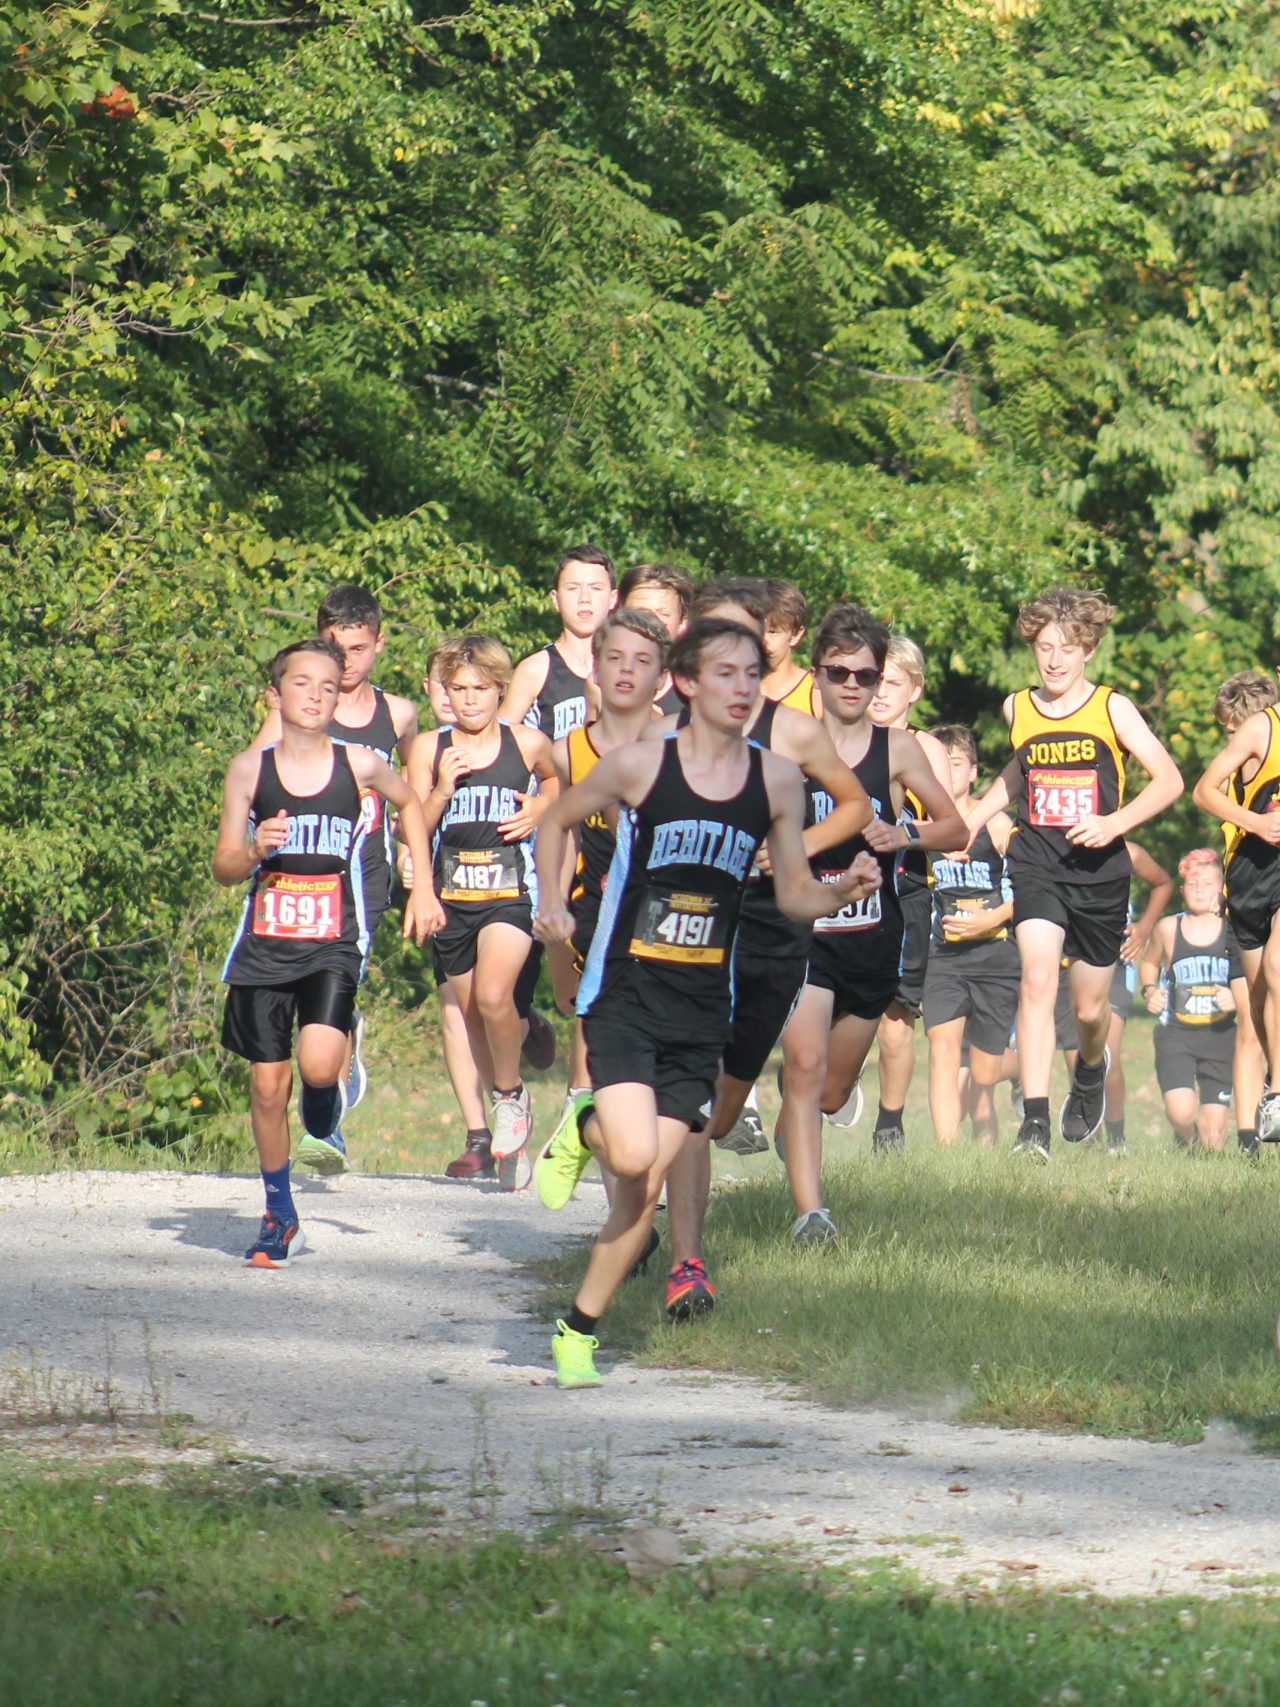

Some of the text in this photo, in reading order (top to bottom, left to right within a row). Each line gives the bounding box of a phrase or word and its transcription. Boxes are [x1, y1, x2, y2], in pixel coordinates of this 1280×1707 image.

[1026, 738, 1096, 765] JONES
[1034, 788, 1093, 815] 2435
[647, 819, 756, 881] HERITAGE
[452, 863, 503, 889] 4187
[263, 893, 333, 925] 1691
[656, 912, 714, 945] 4191
